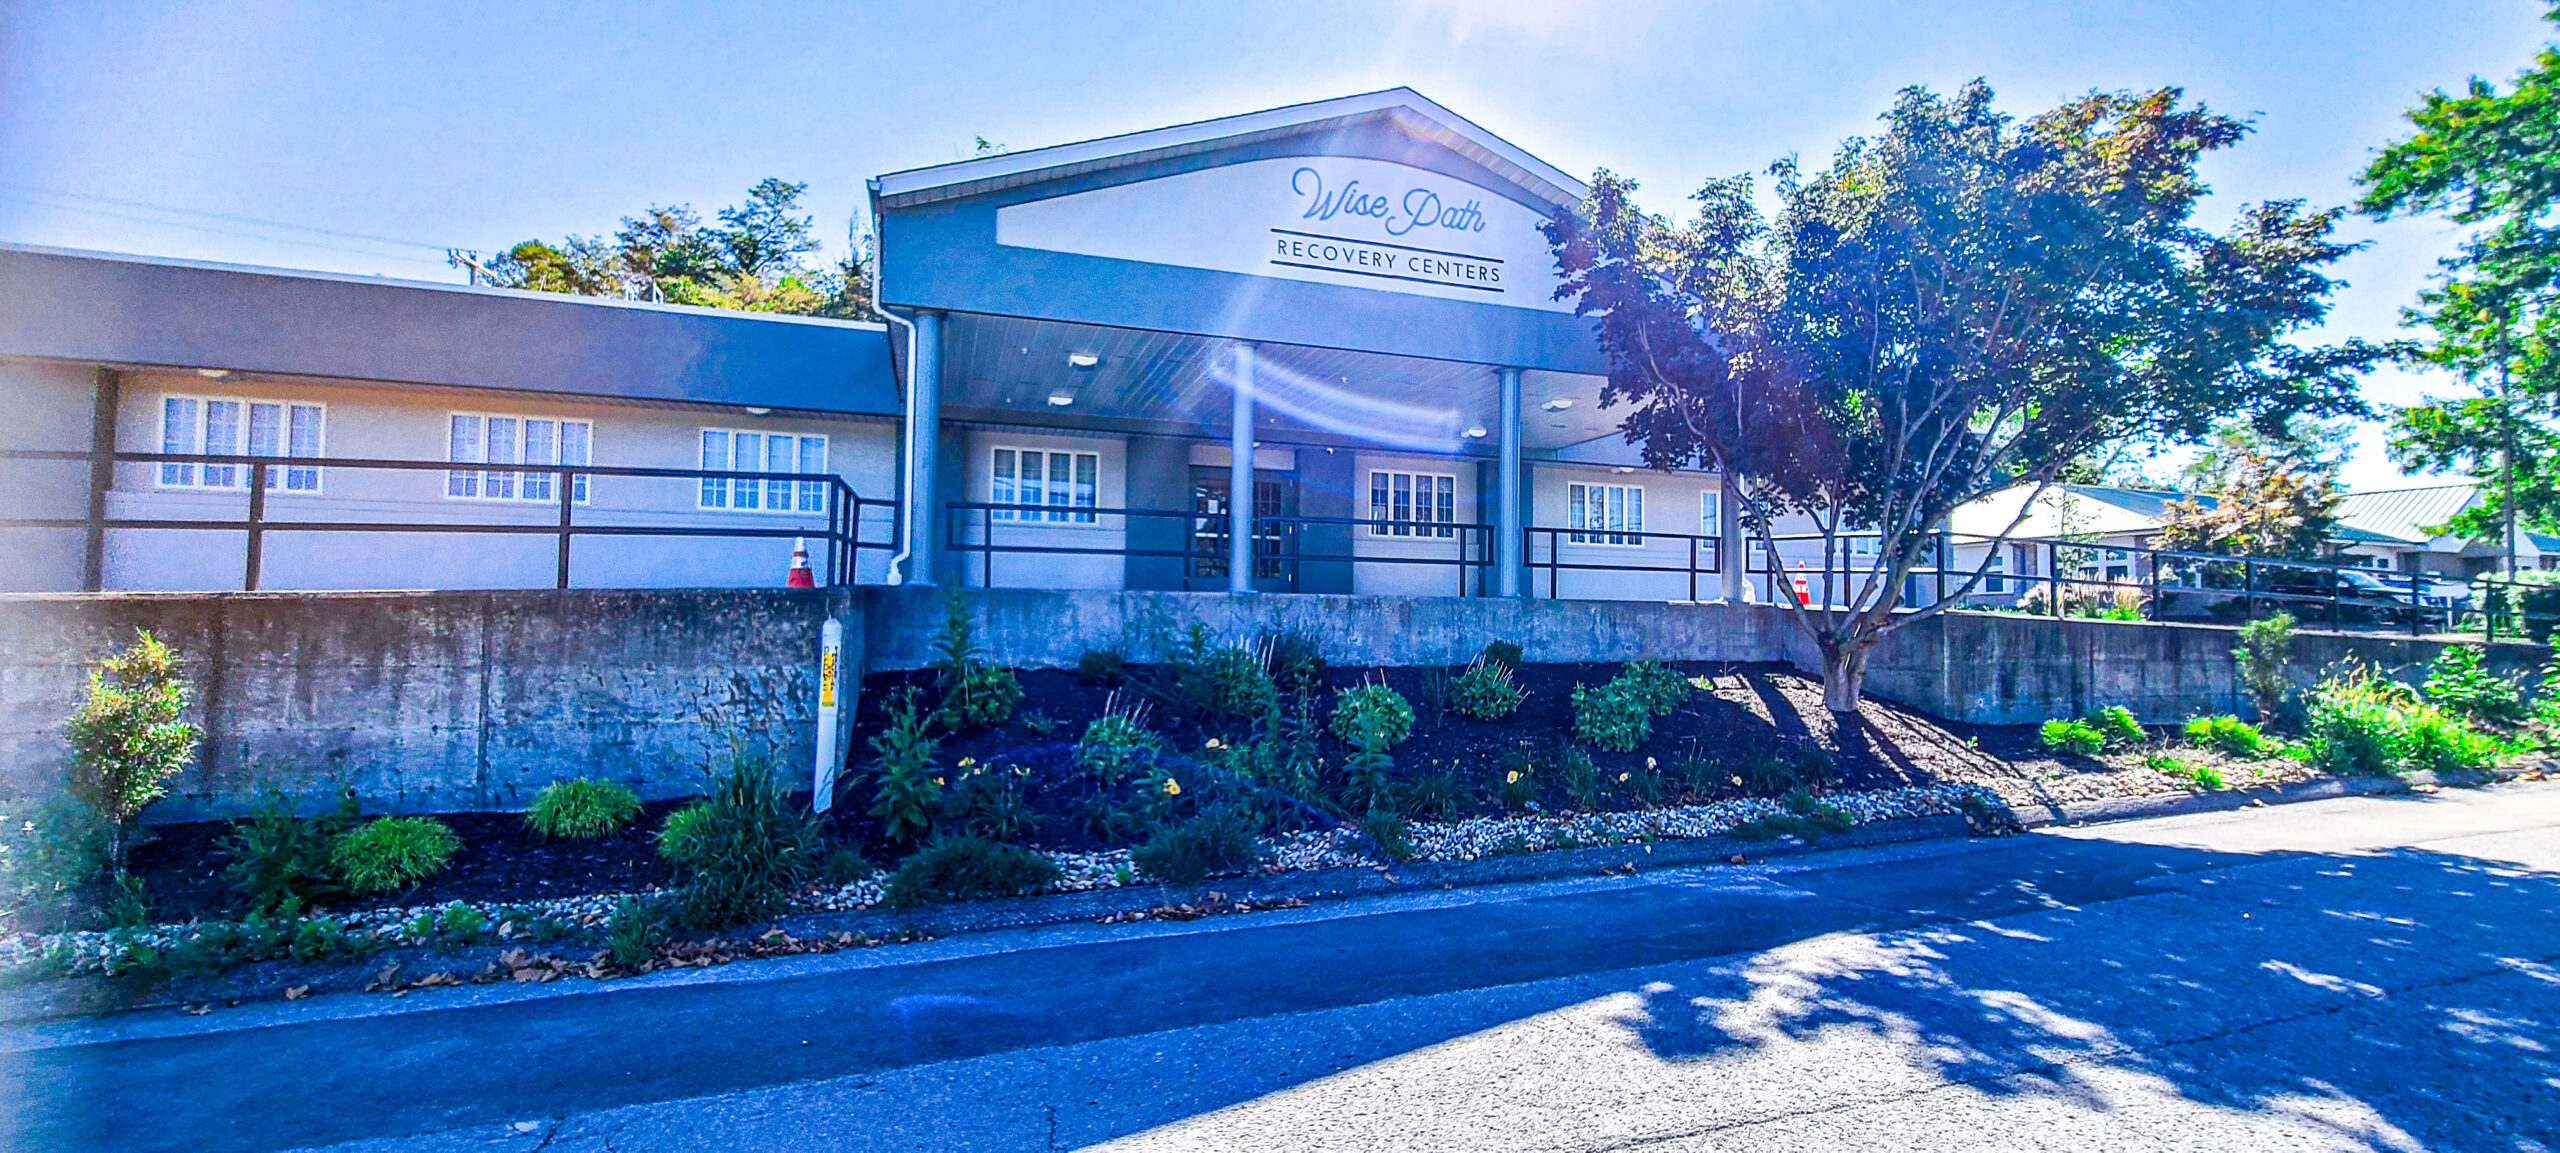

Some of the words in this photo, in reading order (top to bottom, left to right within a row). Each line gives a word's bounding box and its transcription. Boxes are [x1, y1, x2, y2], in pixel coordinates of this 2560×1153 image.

[1292, 167, 1389, 221] Wise
[1385, 188, 1486, 236] Path
[1277, 239, 1396, 268] RECOVERY
[1408, 257, 1500, 282] CENTERS
